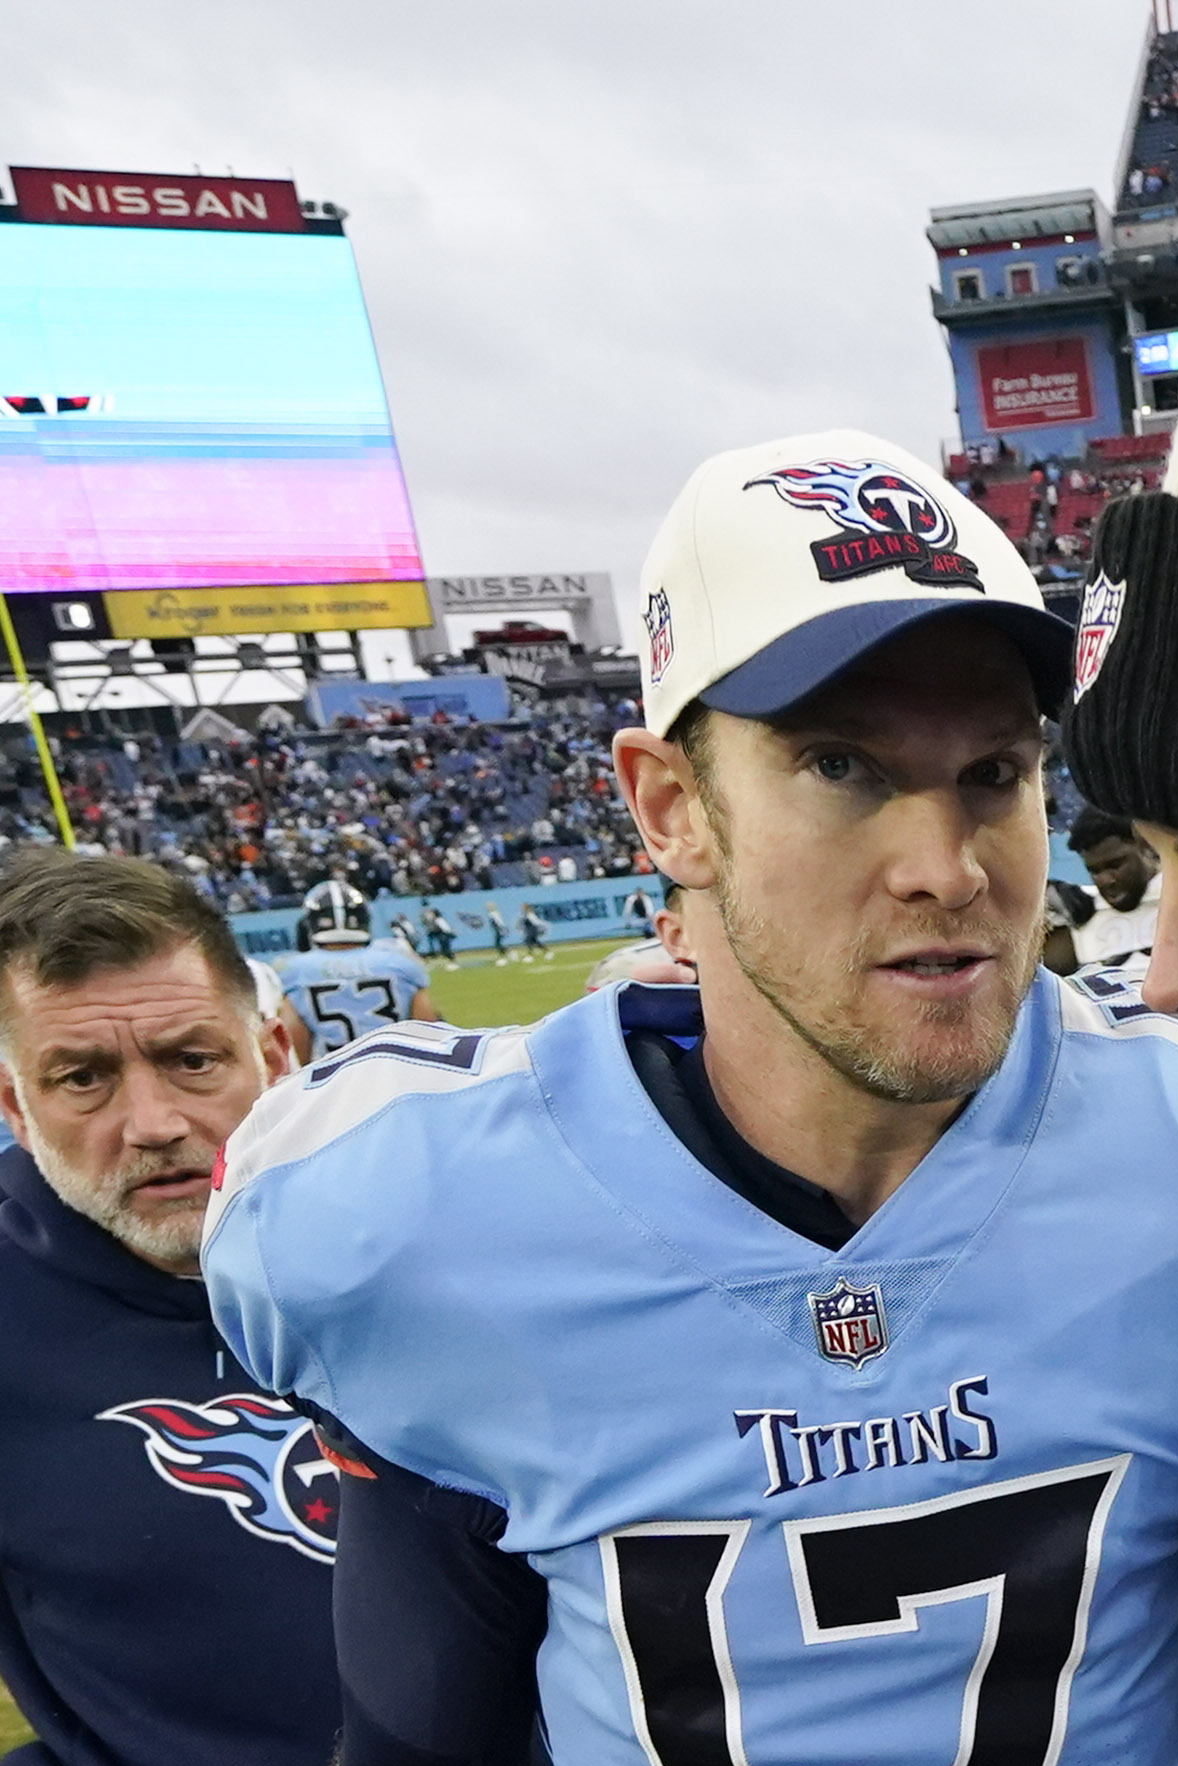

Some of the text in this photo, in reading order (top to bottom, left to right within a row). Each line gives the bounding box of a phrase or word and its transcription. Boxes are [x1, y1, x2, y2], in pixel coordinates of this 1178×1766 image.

[52, 183, 268, 220] NISSAN
[821, 533, 920, 569] TITANS
[932, 555, 965, 574] AFC
[441, 575, 587, 597] NISSAN
[651, 627, 671, 677] NFL
[306, 978, 400, 1053] 53
[825, 1318, 878, 1354] NFL
[733, 1374, 998, 1498] TITANS
